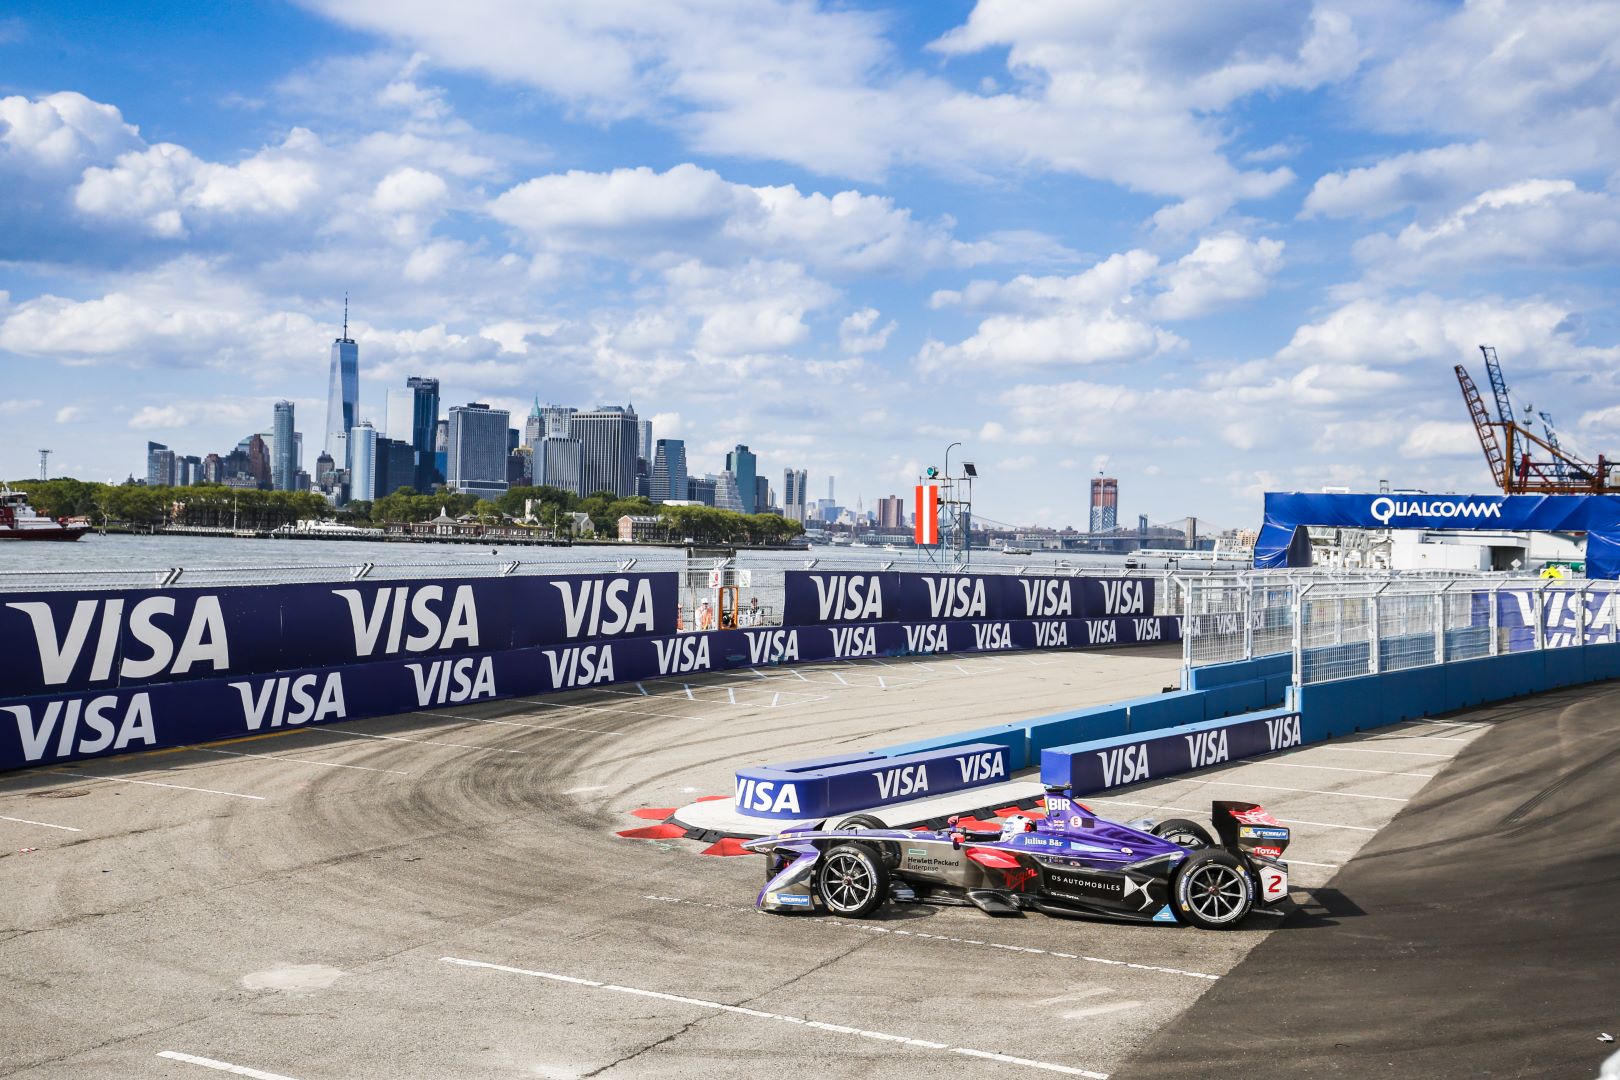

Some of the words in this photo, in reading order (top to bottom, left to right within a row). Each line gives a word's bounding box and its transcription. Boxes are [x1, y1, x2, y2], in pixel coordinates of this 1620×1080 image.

[1371, 497, 1502, 524] QUALCOMM
[549, 578, 654, 638] VISA
[809, 575, 883, 621] VISA
[921, 577, 986, 618] VISA
[1019, 579, 1072, 616] VISA
[1099, 580, 1144, 614] VISA
[1508, 591, 1620, 629] VISA
[332, 584, 480, 657] VISA
[972, 622, 1012, 649] VISA
[1032, 621, 1068, 647] VISA
[1085, 619, 1117, 644] VISA
[1132, 618, 1161, 641] VISA
[1176, 616, 1200, 638] VSA
[1216, 613, 1237, 634] VISA
[6, 595, 229, 685] VISA
[651, 635, 711, 675] VISA
[744, 629, 799, 664] VISA
[828, 626, 876, 657] VISA
[902, 624, 948, 652] VISA
[404, 656, 497, 707] VISA
[542, 644, 615, 689] VISA
[227, 672, 346, 731] VISA
[0, 692, 156, 761] VISA
[1265, 715, 1301, 750] VISA
[1097, 743, 1149, 788] VISA
[1185, 729, 1229, 768] VISA
[872, 764, 928, 799] VISA
[956, 751, 1004, 783] VISA
[735, 775, 800, 814] VISA
[1048, 798, 1071, 811] BIR
[1024, 837, 1047, 846] Julius
[1255, 847, 1280, 855] TOTAL
[907, 856, 934, 865] Hewlett
[934, 858, 960, 867] Packard
[907, 863, 939, 871] Enterprise
[1051, 874, 1062, 882] DS
[1063, 877, 1121, 892] AUTOMOBILES
[1268, 875, 1282, 893] 2
